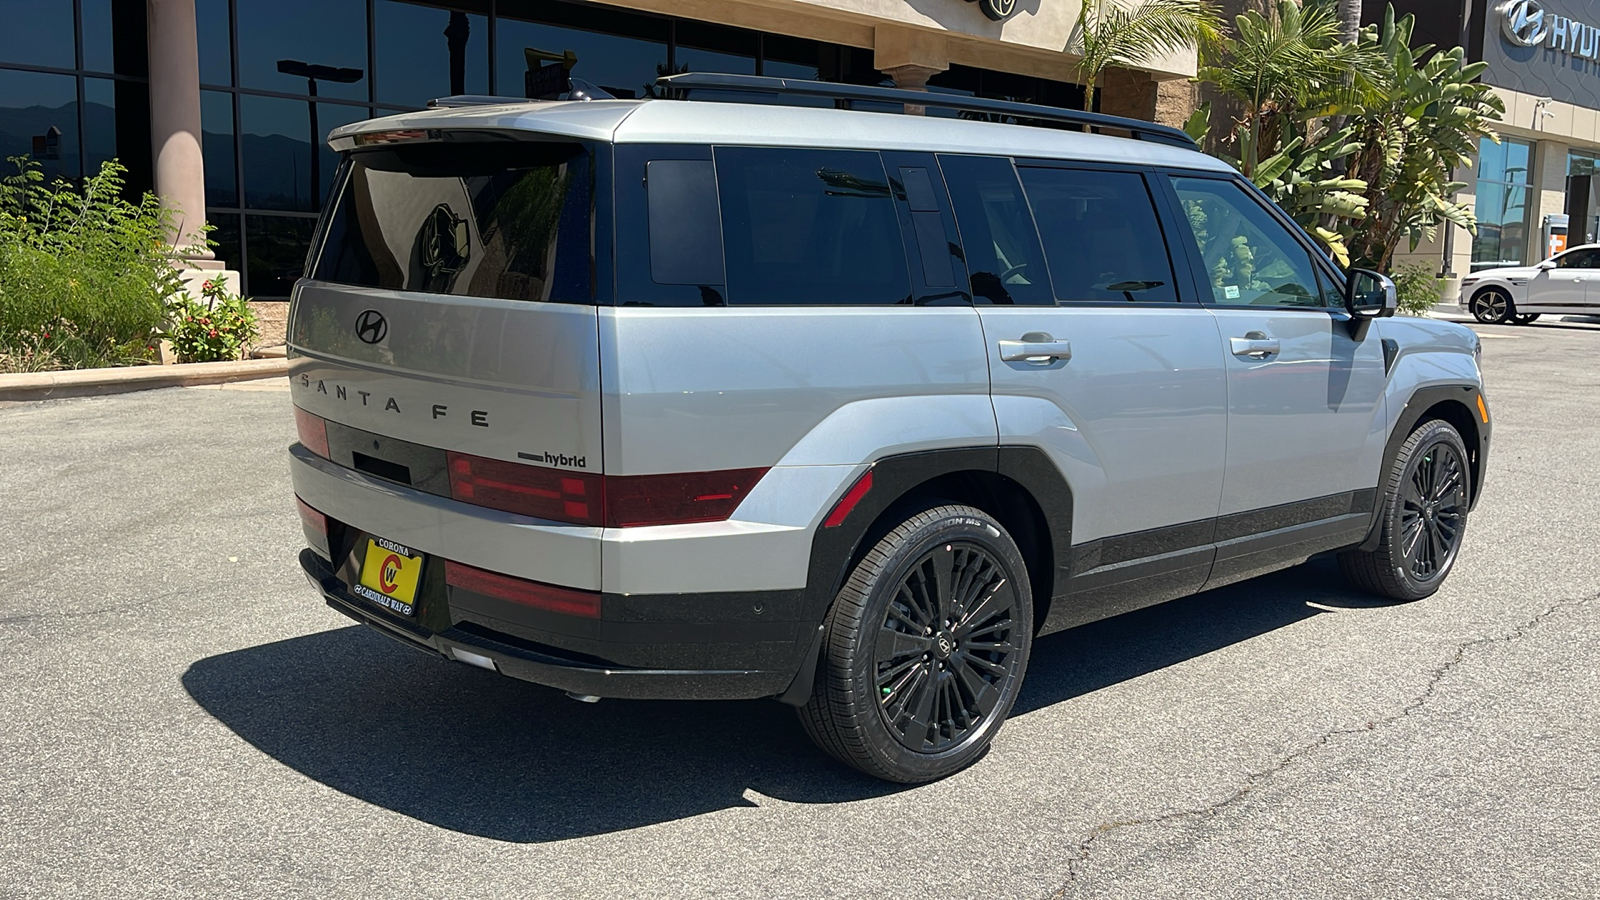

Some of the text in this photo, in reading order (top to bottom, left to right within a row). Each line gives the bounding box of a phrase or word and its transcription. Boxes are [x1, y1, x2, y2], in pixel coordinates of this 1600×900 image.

[301, 374, 489, 427] SANTA FE
[544, 451, 586, 468] hybrid
[379, 538, 409, 556] CORONA
[361, 587, 404, 612] CARDINALE WAY
